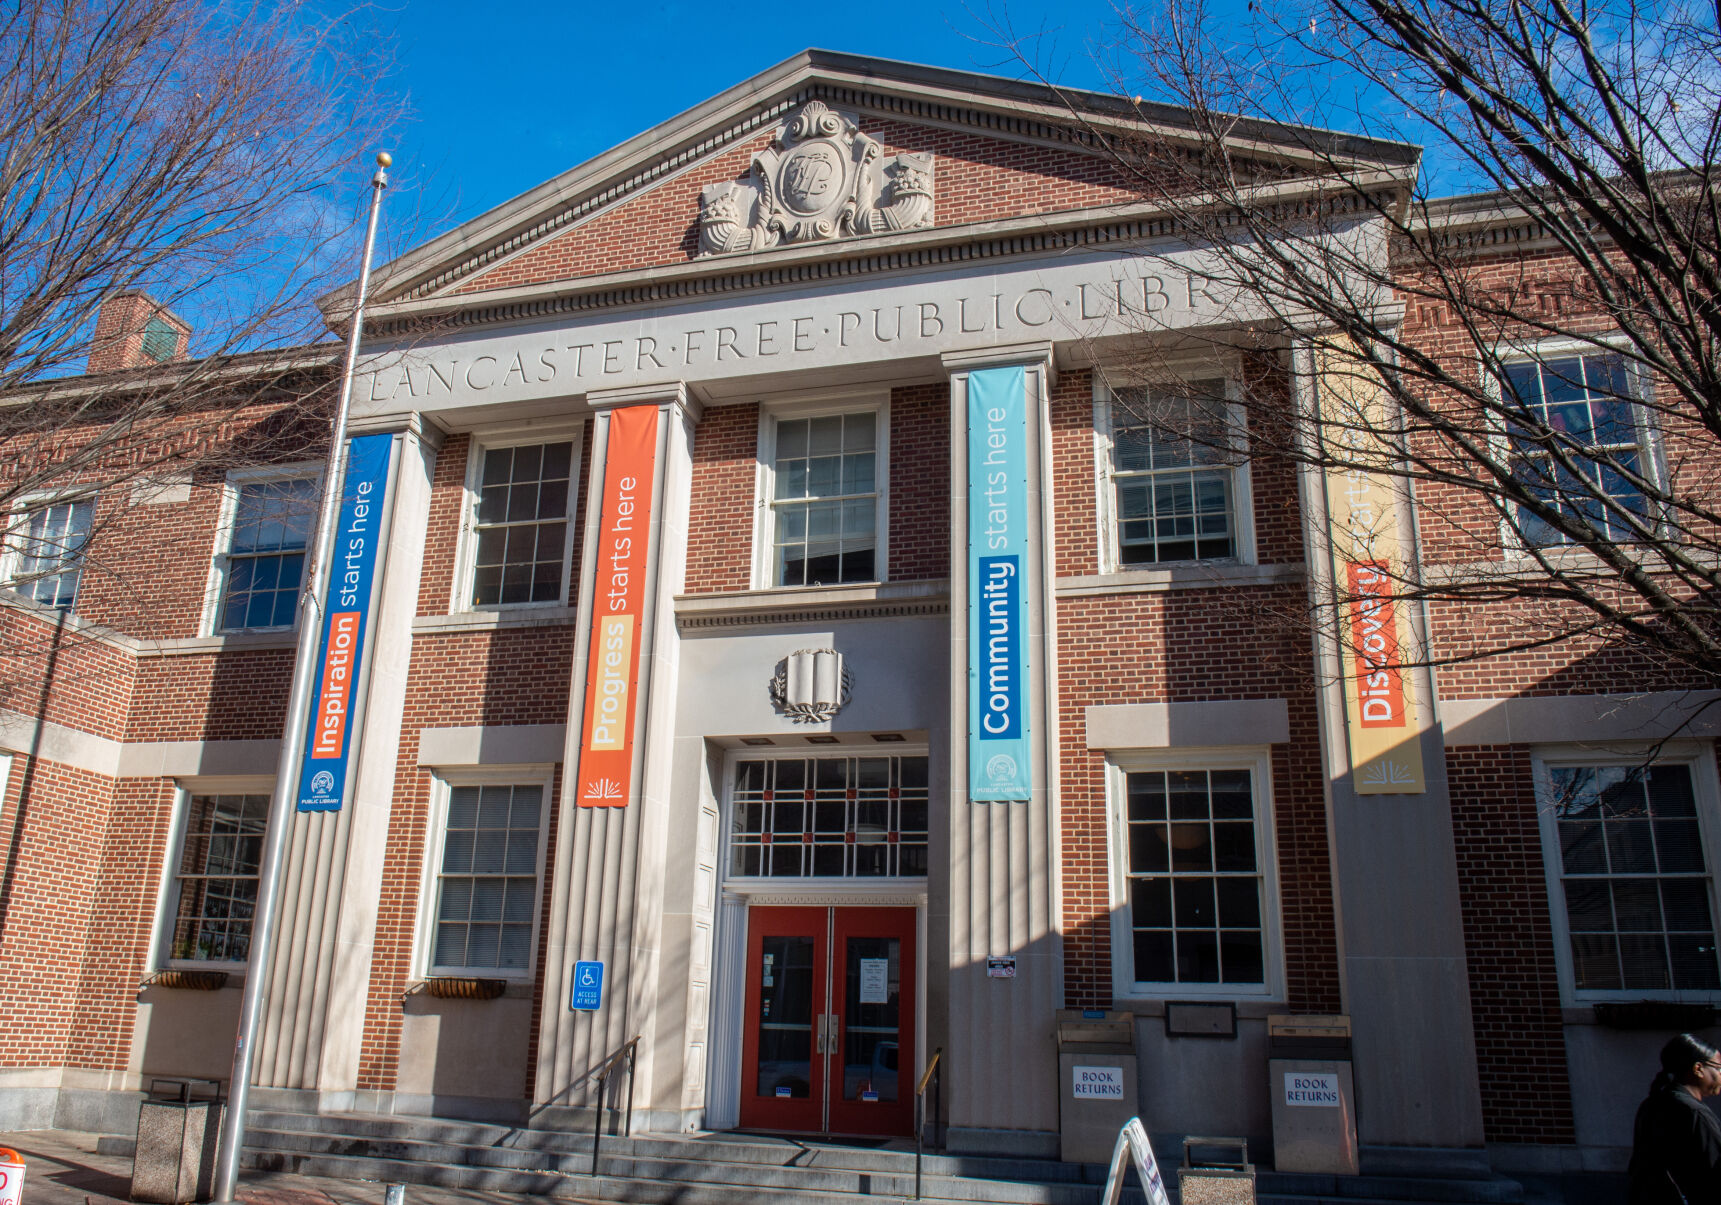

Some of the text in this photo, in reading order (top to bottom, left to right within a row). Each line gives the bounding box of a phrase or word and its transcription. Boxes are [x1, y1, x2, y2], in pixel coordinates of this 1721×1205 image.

[369, 336, 665, 402] LANCASTER
[684, 316, 816, 365] FREE
[837, 287, 1056, 347] PUBLIC
[983, 407, 1016, 735] Community starts here
[316, 481, 373, 754] Inspiration starts here
[593, 476, 637, 745] Progress starts here
[1075, 1083, 1122, 1095] RETURNS
[1082, 1071, 1113, 1082] BOOK
[1287, 1090, 1337, 1102] RETURNS
[1294, 1078, 1328, 1089] BOOK
